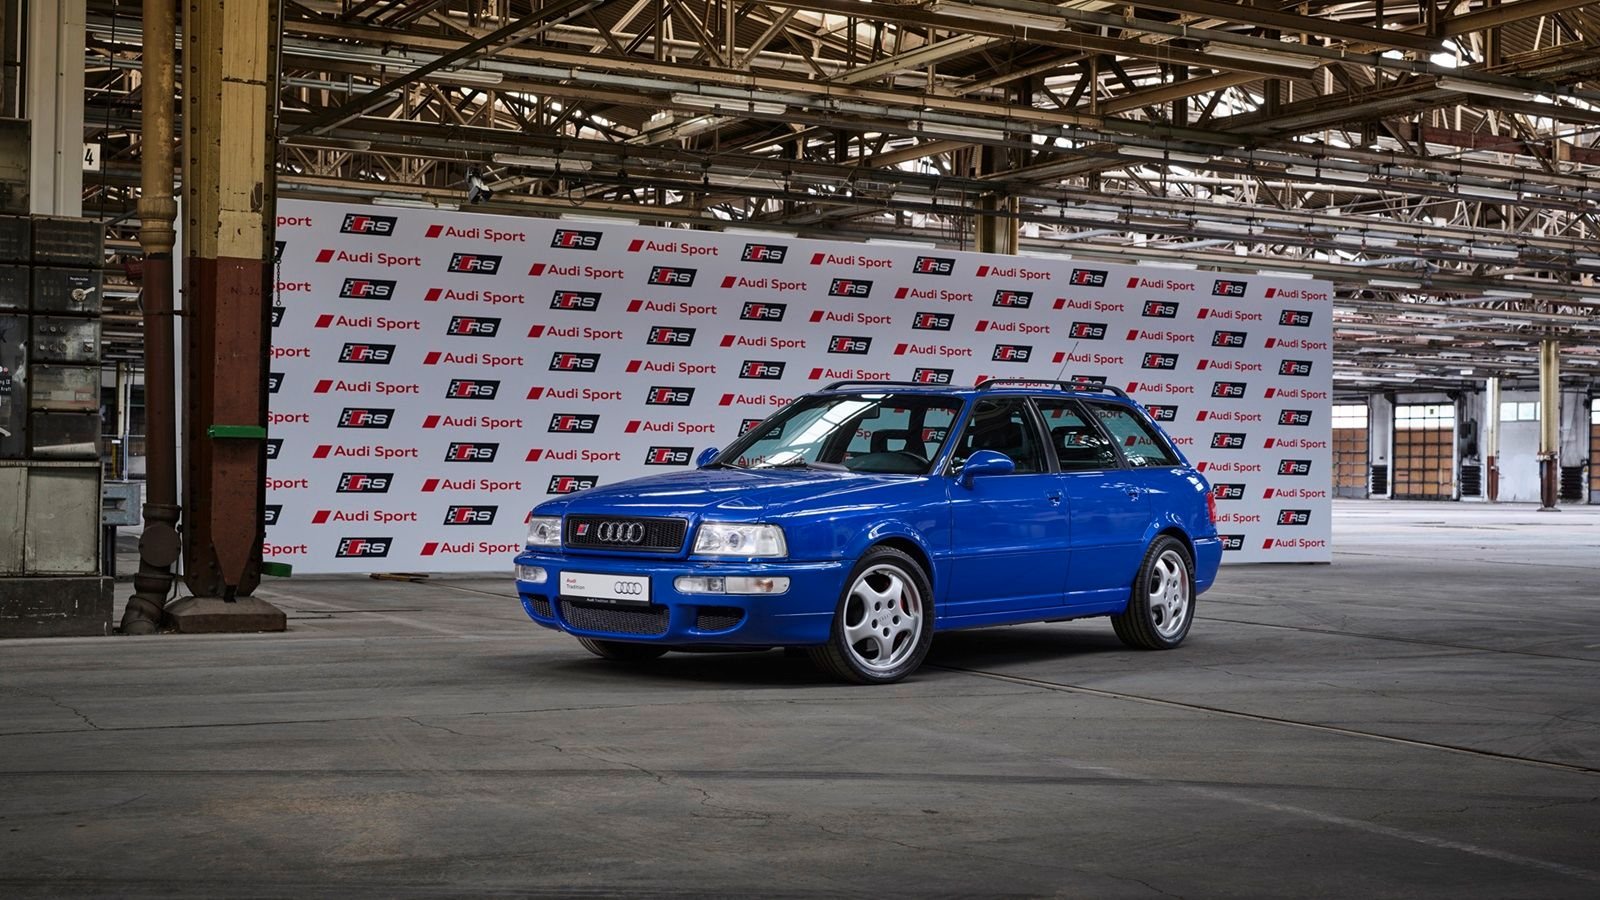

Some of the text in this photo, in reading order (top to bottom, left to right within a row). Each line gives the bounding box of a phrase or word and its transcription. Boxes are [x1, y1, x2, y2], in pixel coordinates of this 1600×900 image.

[85, 148, 94, 166] 4
[276, 216, 311, 226] port
[445, 225, 525, 241] Audi Sport
[645, 240, 718, 255] Audi Sport
[336, 250, 421, 266] Audi Sport
[826, 254, 892, 268] Audi Sport
[547, 264, 623, 279] Audi Sport
[990, 267, 1050, 280] Audi Sport
[738, 277, 806, 291] Audi Sport
[1140, 278, 1195, 290] Audi Sport
[444, 289, 524, 304] Audi Sport
[910, 288, 973, 302] Audi Sport
[1278, 288, 1328, 300] Audi Sport
[644, 301, 717, 315] Audi Sport
[1067, 299, 1124, 312] Audi Sport
[825, 311, 891, 325] Audi Sport
[1210, 309, 1263, 321] Audi Sport
[335, 315, 420, 330] Audi Sport
[990, 321, 1050, 334] Audi Sport
[546, 326, 623, 340] Audi Sport
[1140, 330, 1194, 342] Audi Sport
[737, 335, 806, 349] Audi Sport
[1277, 338, 1327, 350] Audi Sport
[909, 344, 972, 357] Audi Sport
[443, 352, 523, 366] Audi Sport
[1066, 352, 1123, 365] Audi Sport
[644, 361, 716, 374] Audi Sport
[1209, 360, 1262, 371] Audi Sport
[825, 369, 890, 381] Audi Sport
[334, 380, 419, 394] Audi Sport
[1139, 382, 1194, 394] Audi Sport
[1276, 388, 1327, 399] Audi Sport
[545, 387, 622, 401] Audi Sport
[736, 394, 793, 407] Audi Spo
[442, 415, 522, 429] Audi Sport
[1209, 411, 1261, 422] Audi Sport
[643, 421, 715, 434] Audi Sport
[1276, 438, 1326, 449] Audi Sport
[333, 445, 418, 459] Audi Sport
[545, 449, 621, 462] Audi Sport
[1208, 462, 1261, 473] Audi Sport
[441, 479, 522, 492] Audi Sport
[1275, 488, 1325, 498] Audi Sport
[332, 510, 417, 523] Audi Sport
[1233, 513, 1260, 523] Sport
[440, 542, 521, 554] Audi Sport
[1274, 538, 1325, 548] Audi Sport
[261, 543, 307, 557] Sport
